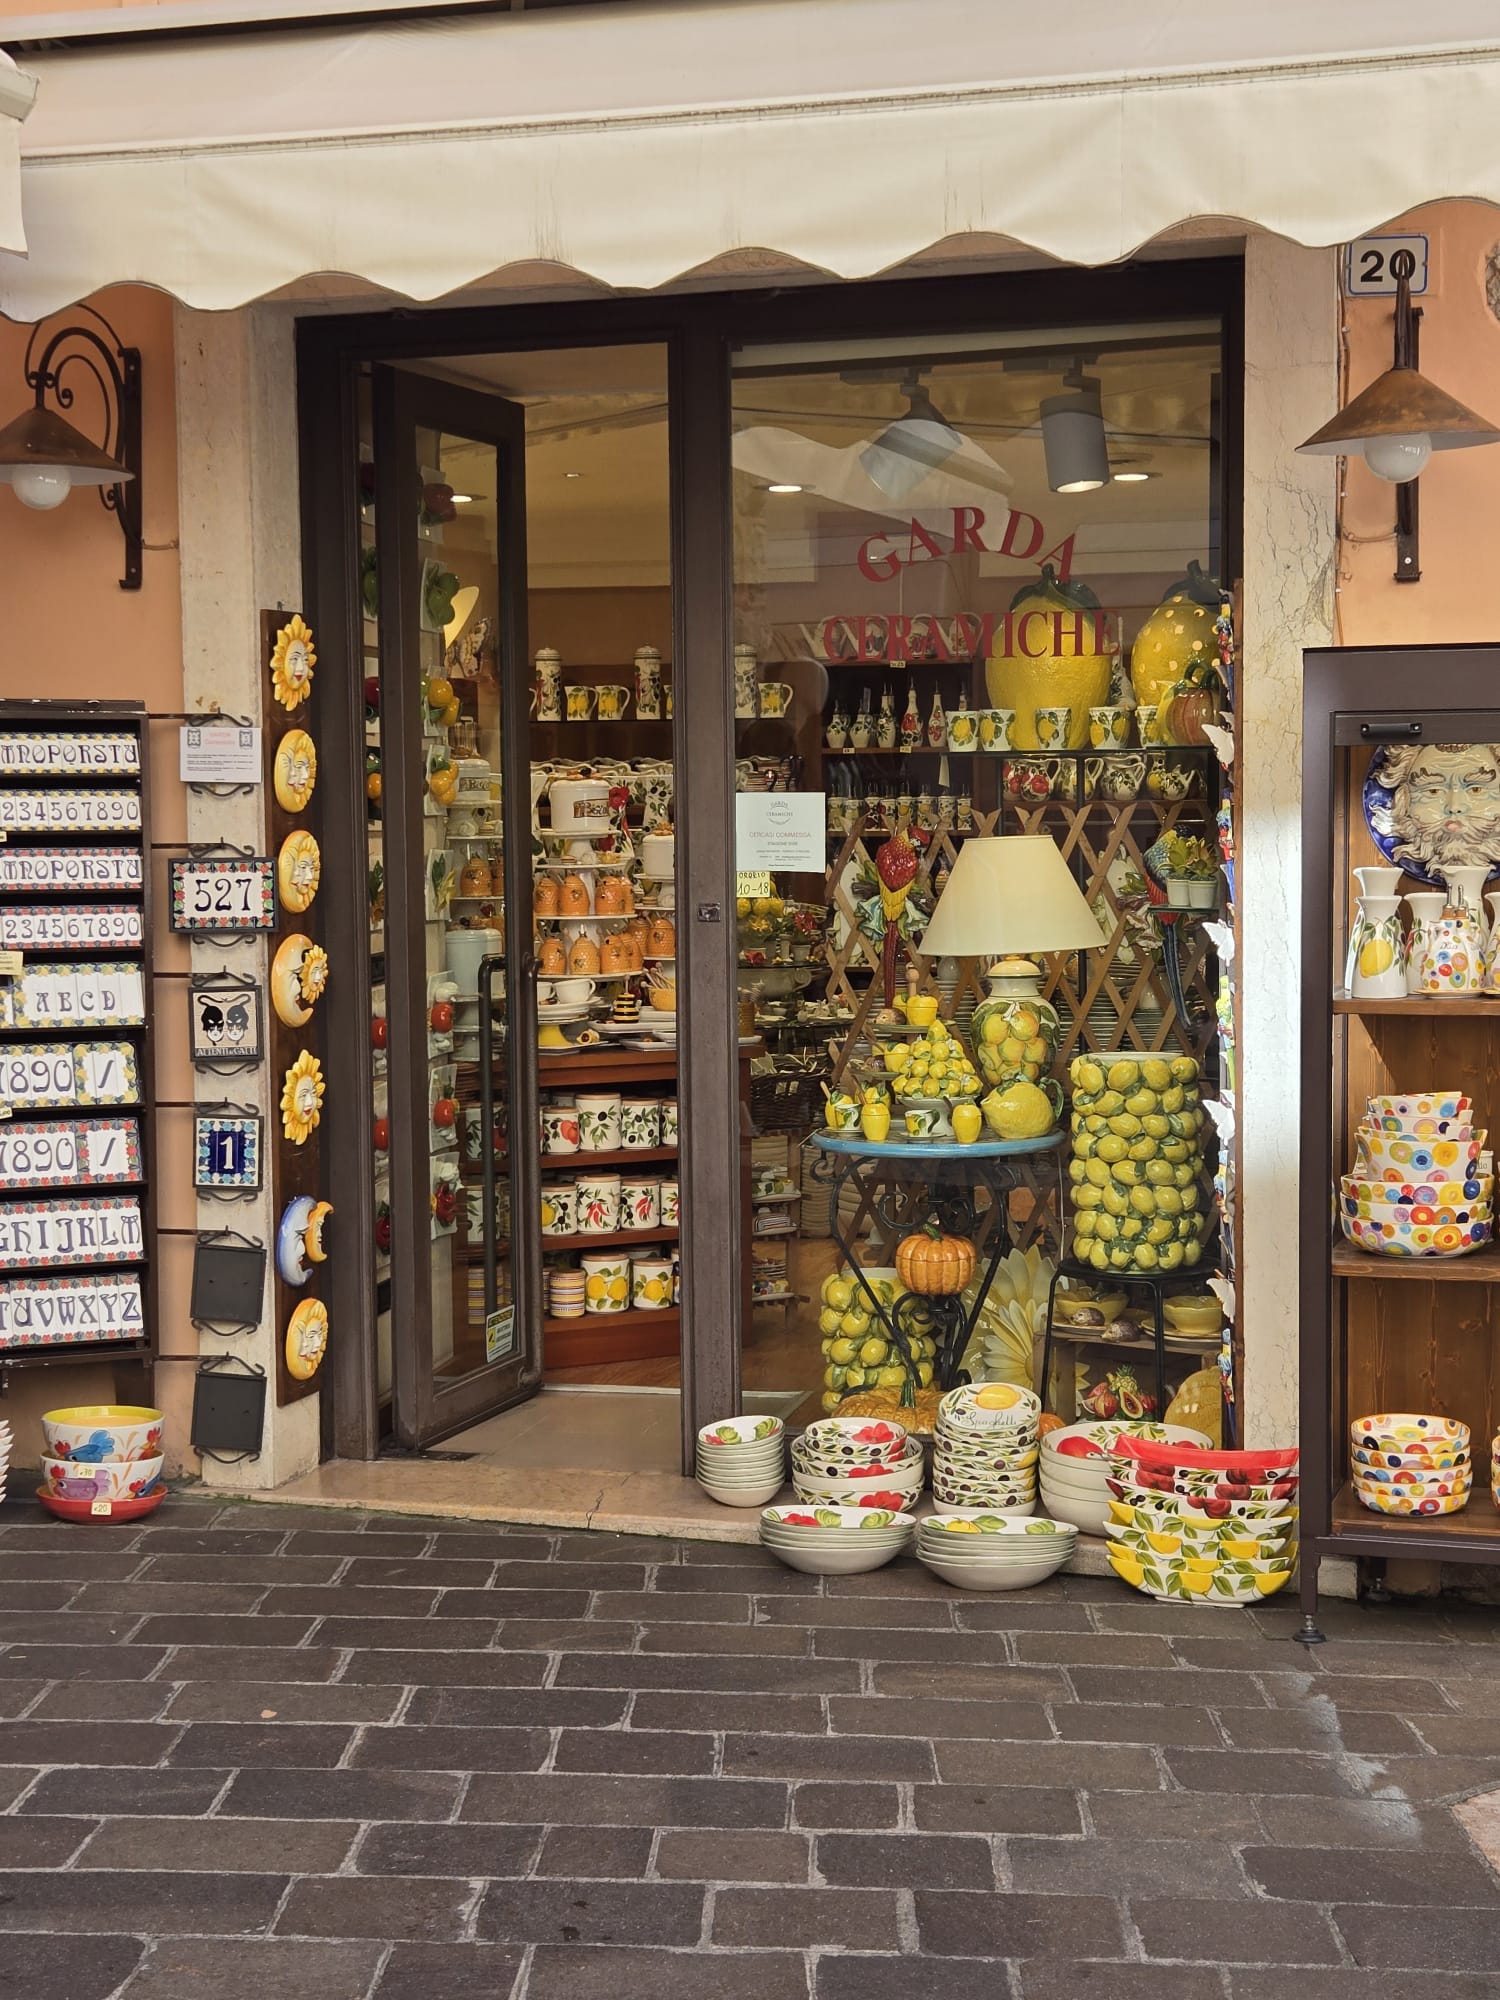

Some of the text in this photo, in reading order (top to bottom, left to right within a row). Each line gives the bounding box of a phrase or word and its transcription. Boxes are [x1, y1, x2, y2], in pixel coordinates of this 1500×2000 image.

[1360, 249, 1416, 283] 20
[857, 506, 1076, 583] GARDA
[823, 610, 1120, 664] CERAMICHE
[194, 878, 252, 912] 527
[219, 1135, 234, 1170] 1
